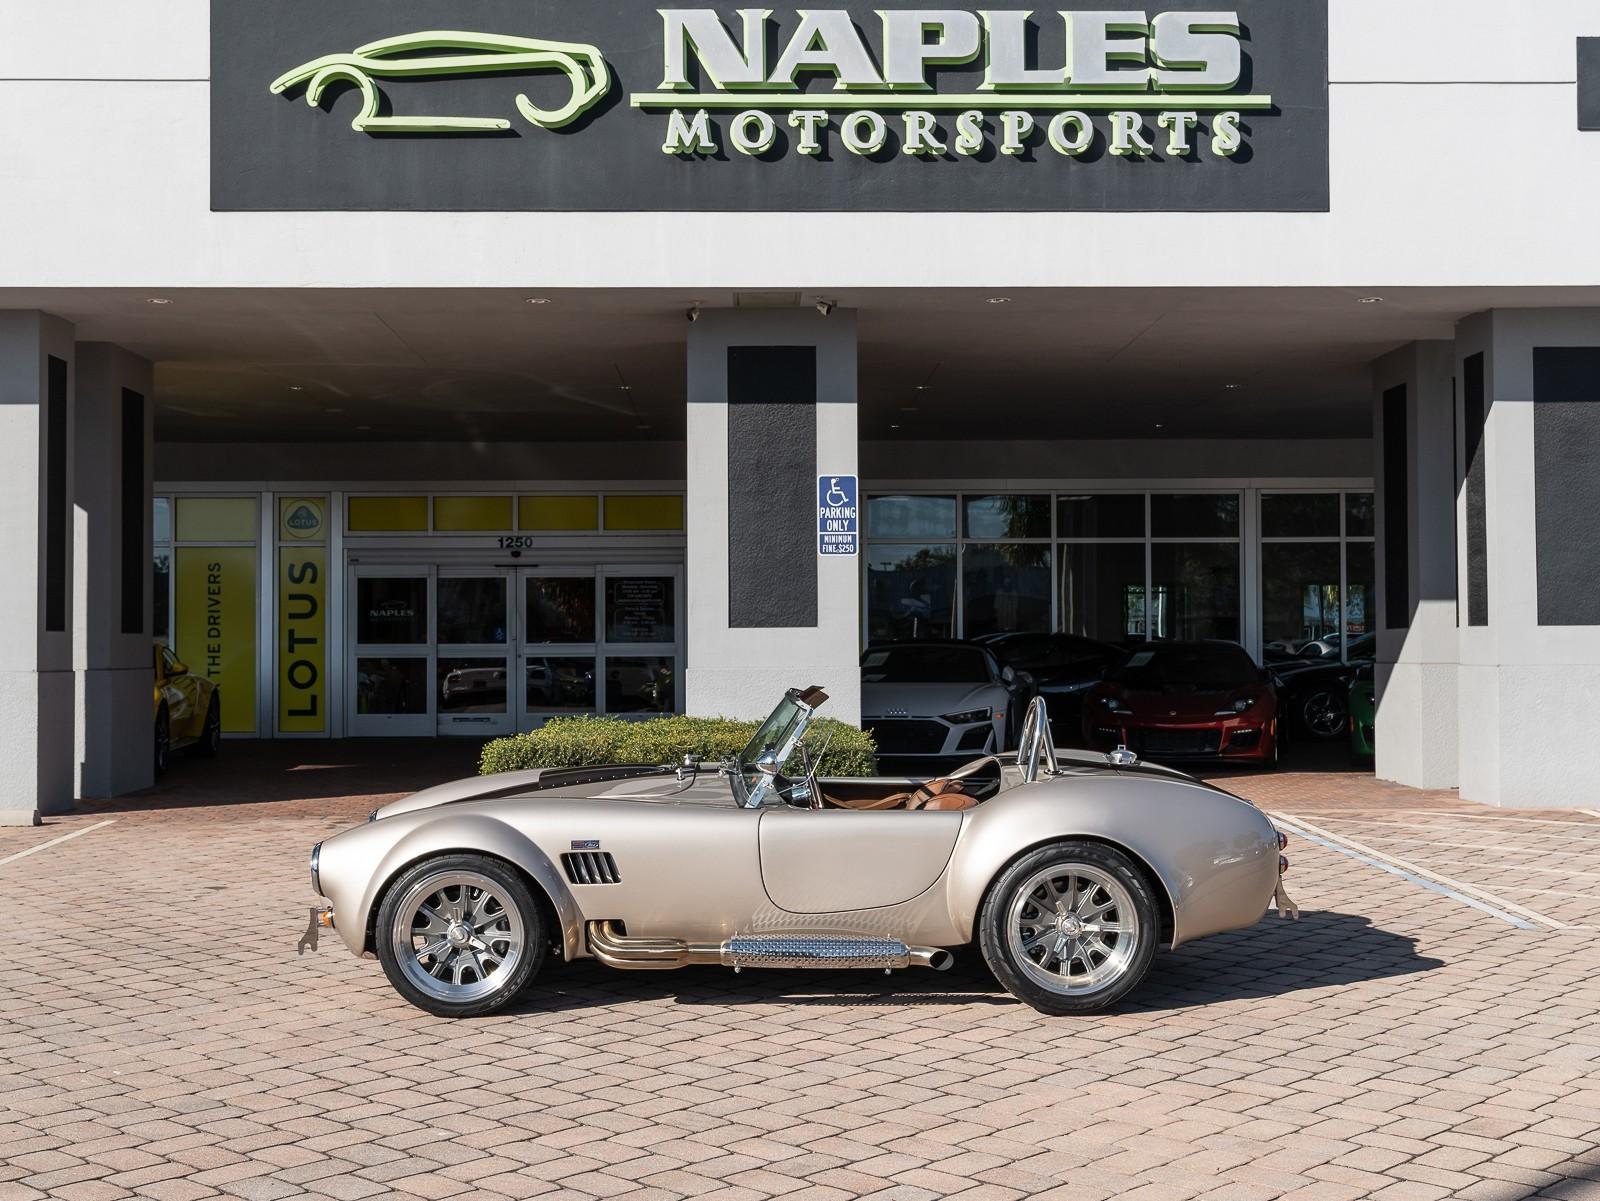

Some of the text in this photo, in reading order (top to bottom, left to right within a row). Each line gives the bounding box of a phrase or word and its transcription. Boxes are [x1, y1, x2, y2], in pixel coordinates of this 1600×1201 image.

[657, 8, 1241, 91] NAPLES
[662, 110, 1241, 155] MOTORSPORTS
[820, 507, 855, 518] PARKING
[826, 519, 849, 532] ONLY
[497, 536, 533, 549] 1250
[824, 535, 852, 543] MINIMUM
[822, 543, 854, 553] FINE $250
[207, 561, 221, 677] THE DRIVERS
[288, 562, 318, 717] LOTUS
